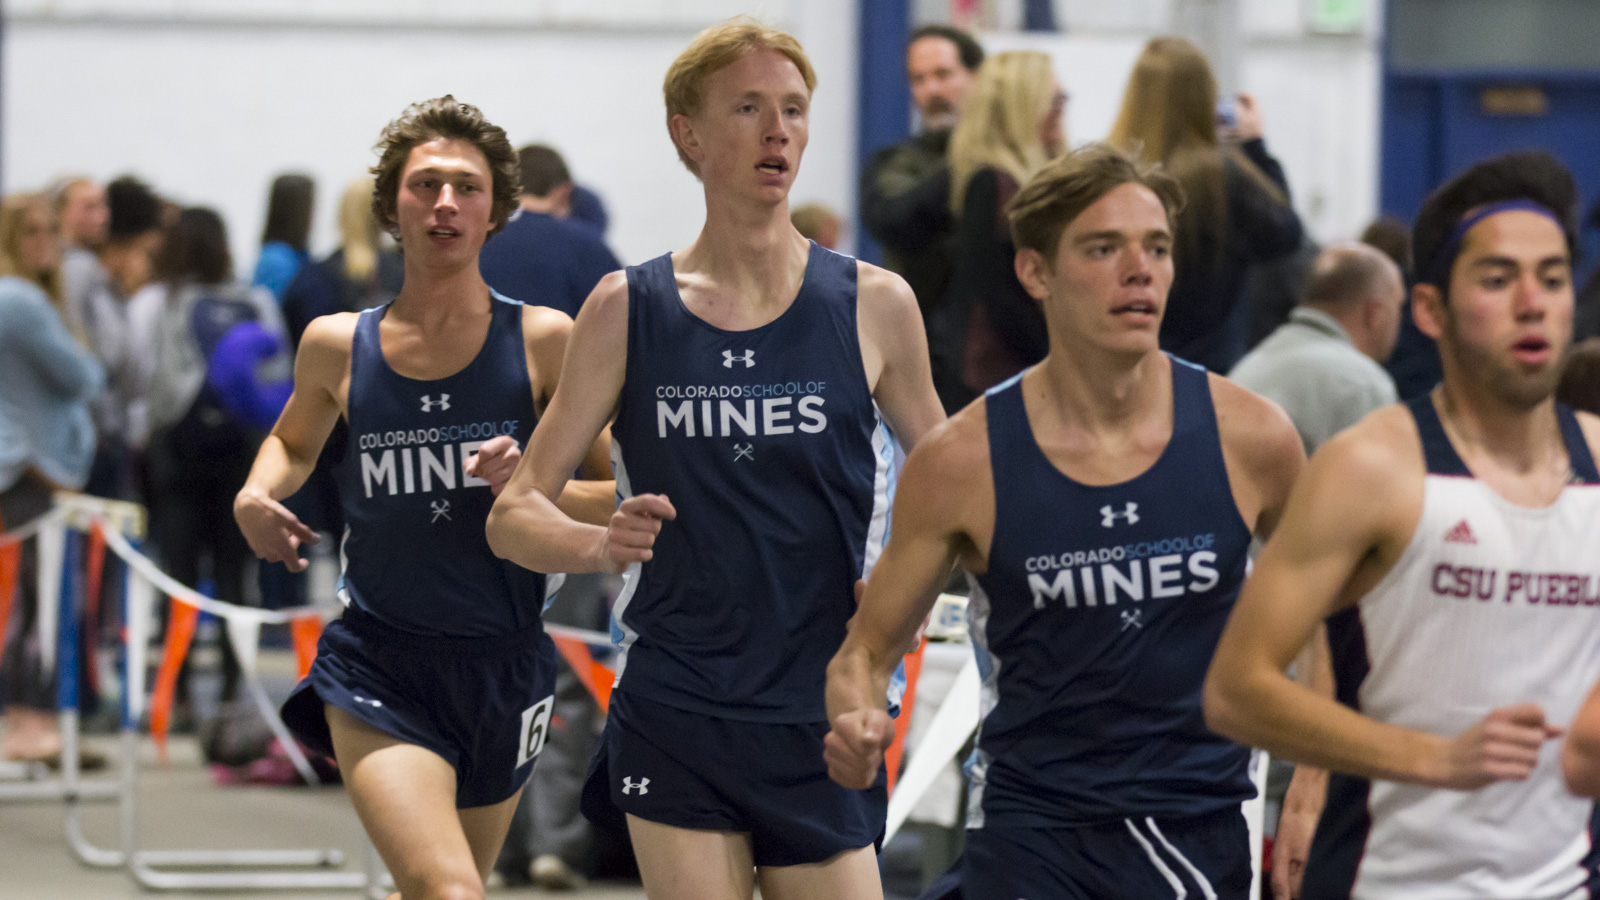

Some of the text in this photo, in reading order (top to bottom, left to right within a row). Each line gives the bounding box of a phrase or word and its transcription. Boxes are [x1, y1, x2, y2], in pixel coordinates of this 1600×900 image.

[656, 395, 827, 438] MINES
[360, 438, 520, 498] MINE
[1027, 550, 1220, 609] MINES
[1431, 562, 1600, 606] CSU PUEBL
[526, 703, 546, 759] 6
